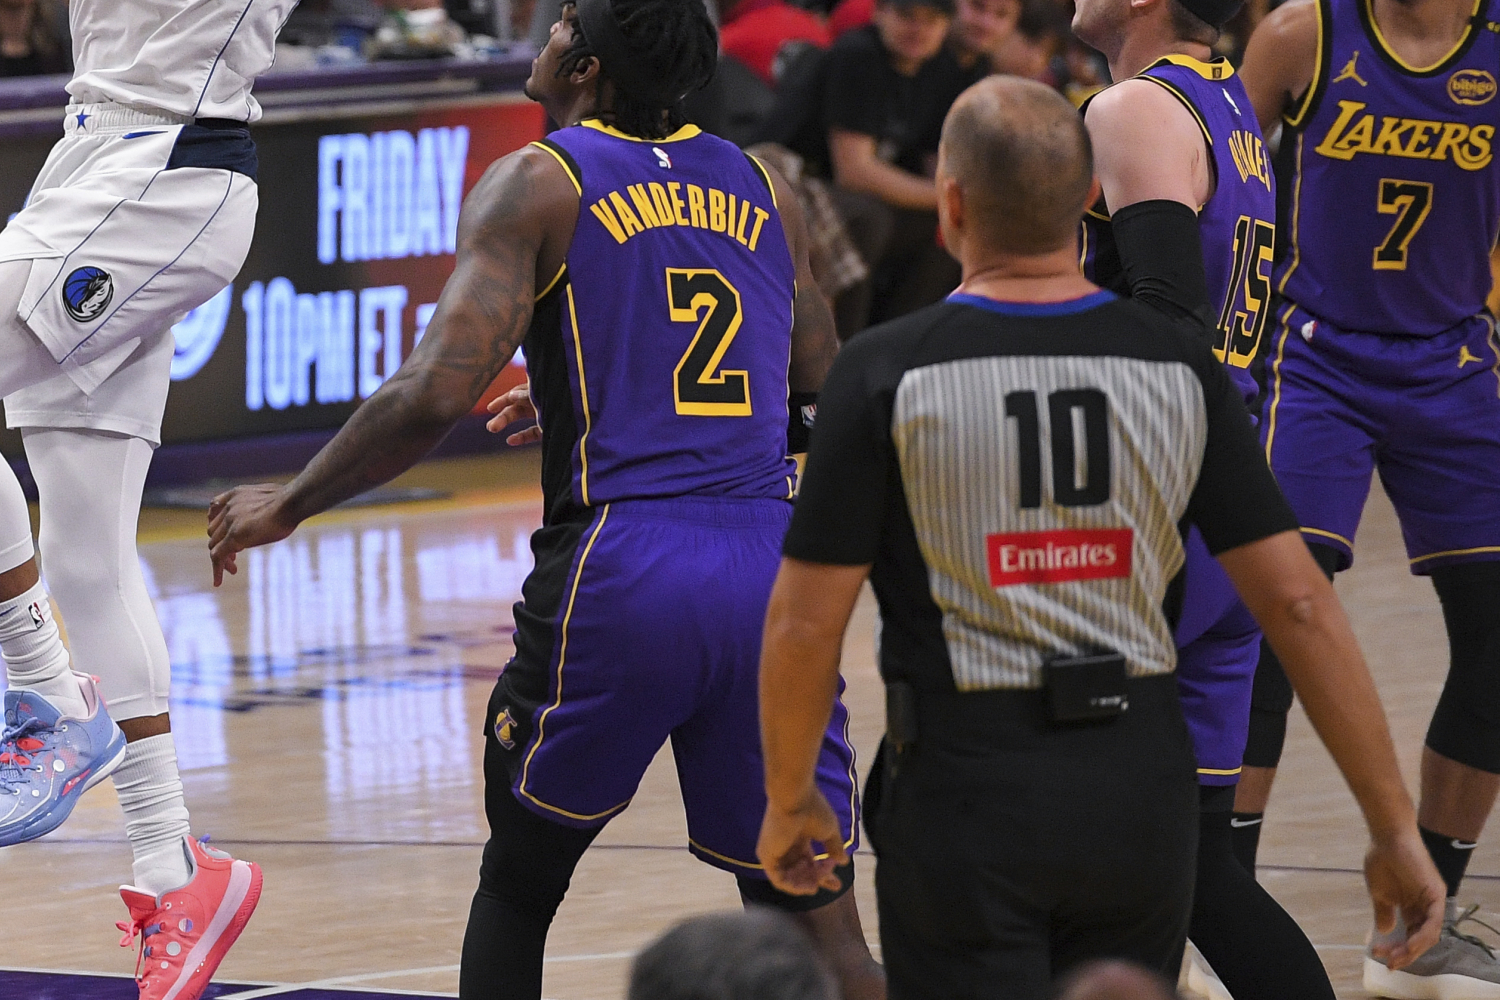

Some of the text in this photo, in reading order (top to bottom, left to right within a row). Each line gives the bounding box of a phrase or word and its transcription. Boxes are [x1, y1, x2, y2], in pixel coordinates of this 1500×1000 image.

[317, 125, 470, 264] FRIDAY
[1315, 100, 1496, 171] LAKERS
[590, 182, 769, 252] VANDERBILT
[1372, 178, 1433, 271] 7
[242, 276, 408, 411] 10PM ET
[666, 267, 752, 416] 2
[1211, 215, 1275, 369] 15
[1004, 388, 1110, 508] 10
[1000, 543, 1117, 573] Emirates
